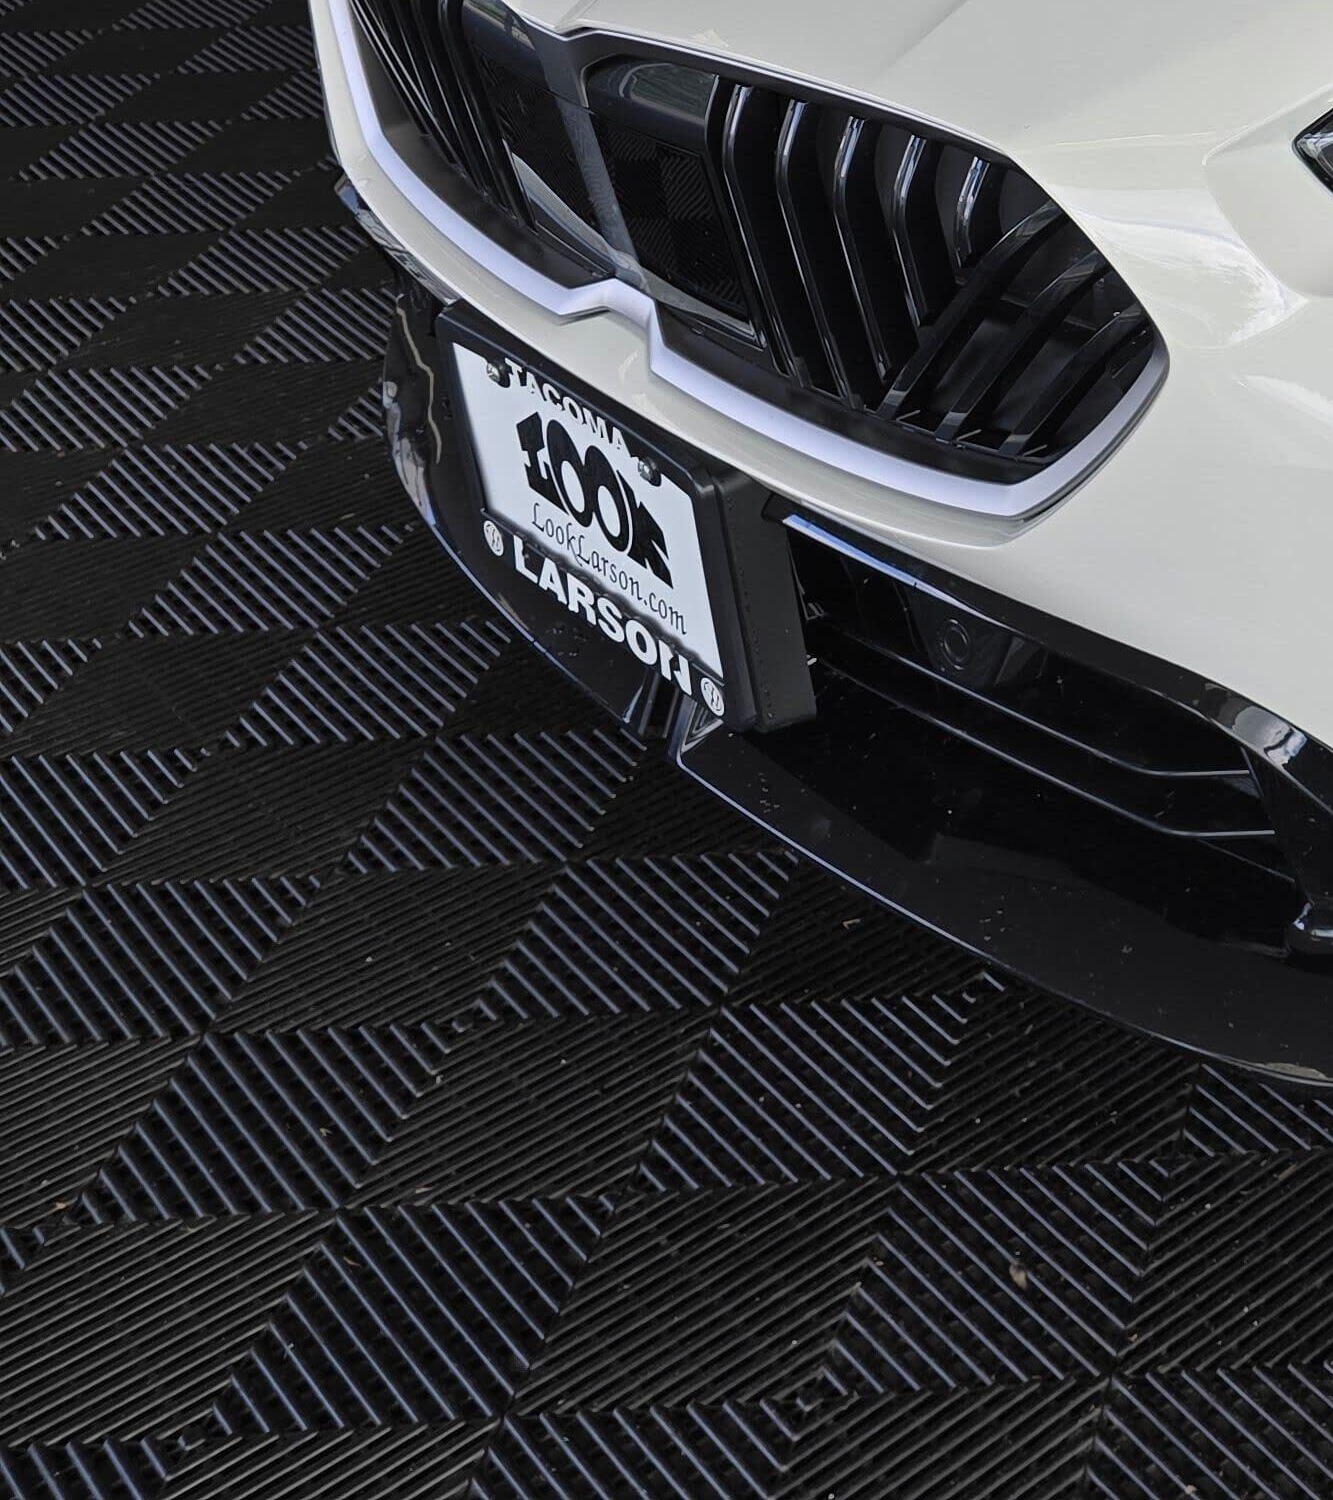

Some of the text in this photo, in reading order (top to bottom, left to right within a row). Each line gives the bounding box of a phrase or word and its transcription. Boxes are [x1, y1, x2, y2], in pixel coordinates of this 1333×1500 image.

[504, 357, 630, 453] TACOMA
[513, 534, 693, 697] LARSON
[532, 502, 687, 636] LookLarson.com
